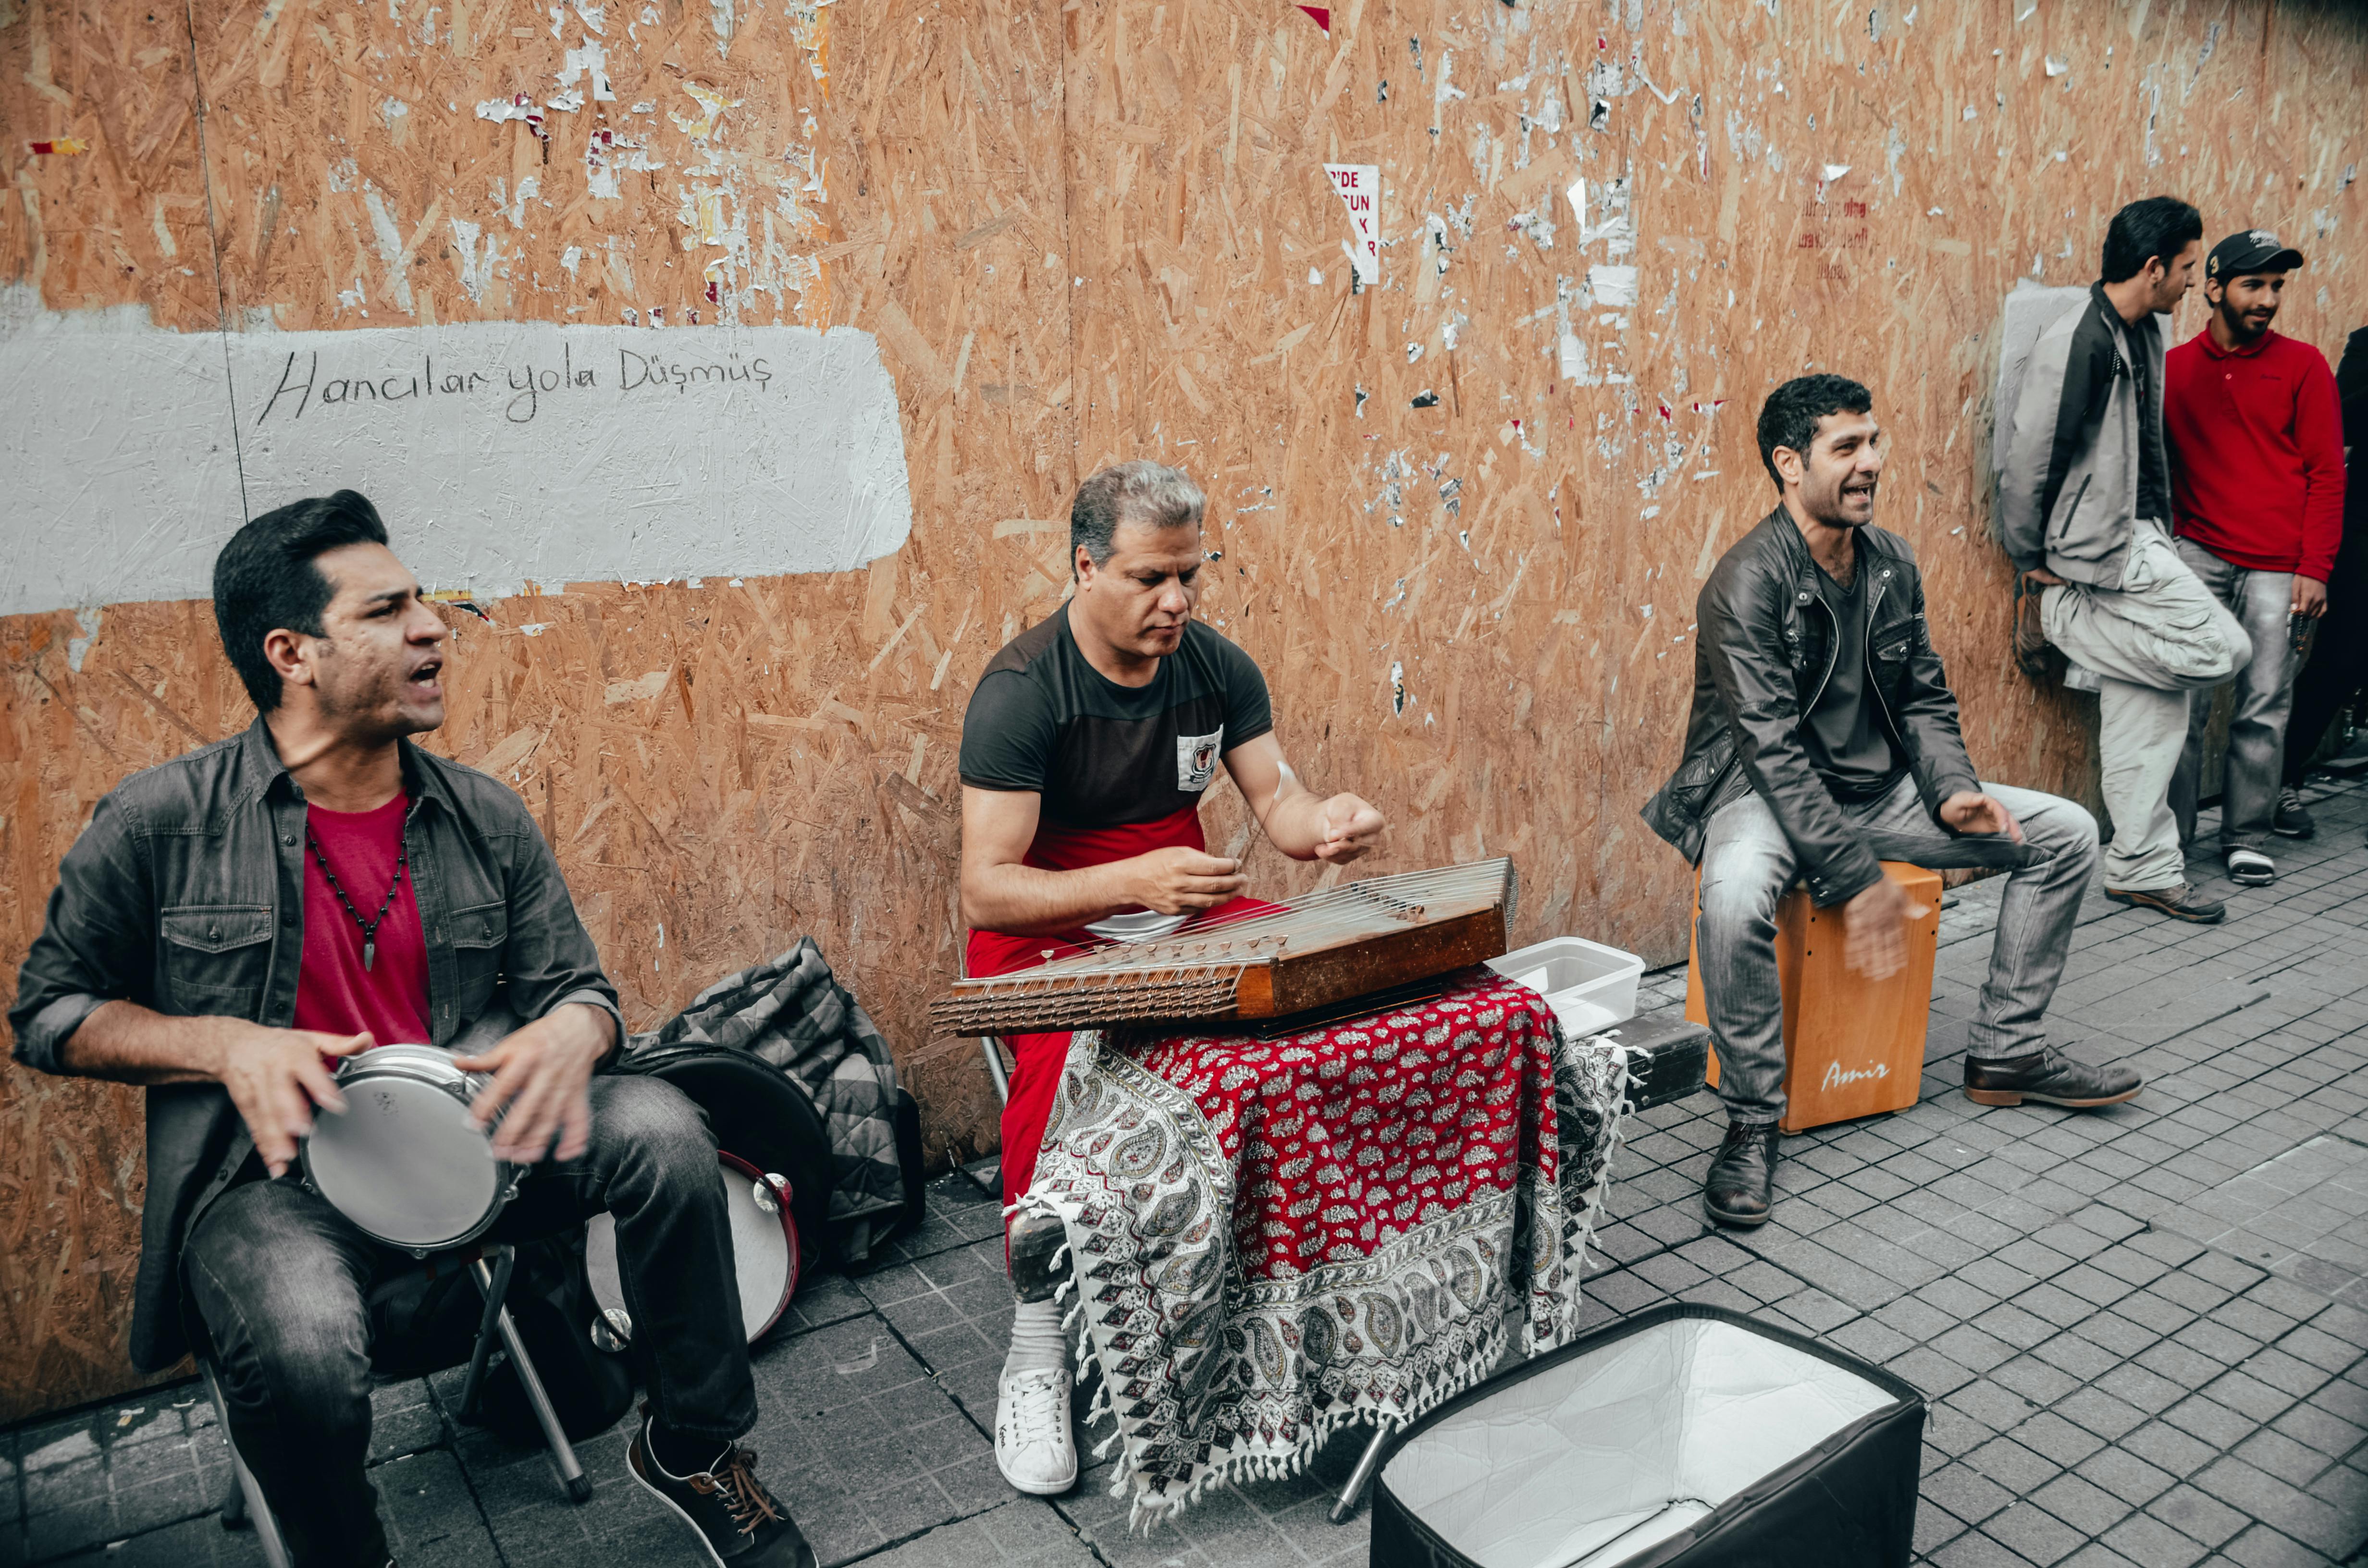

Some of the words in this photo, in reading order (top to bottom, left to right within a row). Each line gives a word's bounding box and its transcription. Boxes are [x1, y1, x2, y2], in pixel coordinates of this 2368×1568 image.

[1343, 195, 1369, 211] UN
[2210, 256, 2219, 274] 3
[506, 342, 597, 423] yola
[618, 348, 773, 394] Düşmüş
[1821, 1059, 1890, 1092] Amir
